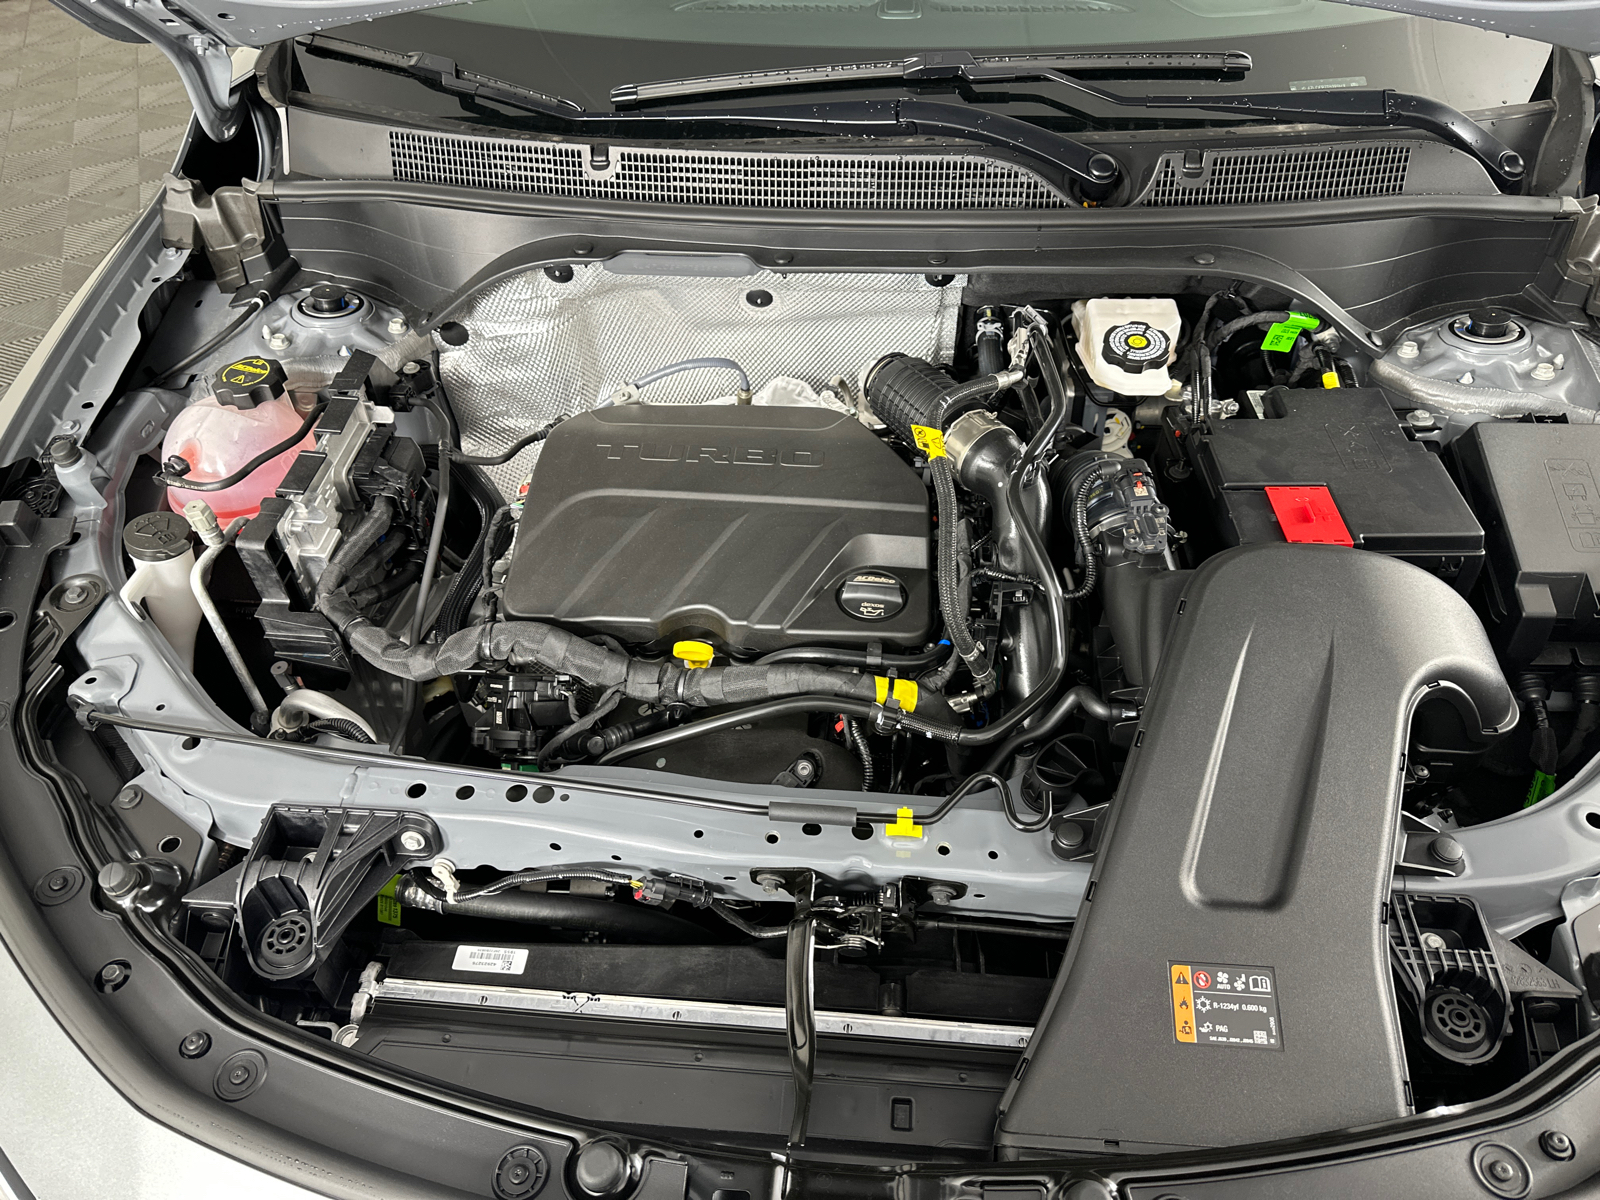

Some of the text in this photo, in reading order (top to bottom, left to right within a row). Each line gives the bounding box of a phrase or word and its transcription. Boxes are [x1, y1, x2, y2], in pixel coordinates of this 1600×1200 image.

[596, 442, 826, 468] TURBO
[853, 575, 896, 584] ACDelco
[1213, 1001, 1267, 1014] R-1234yf 0.600 kg
[1215, 1024, 1229, 1033] PAG
